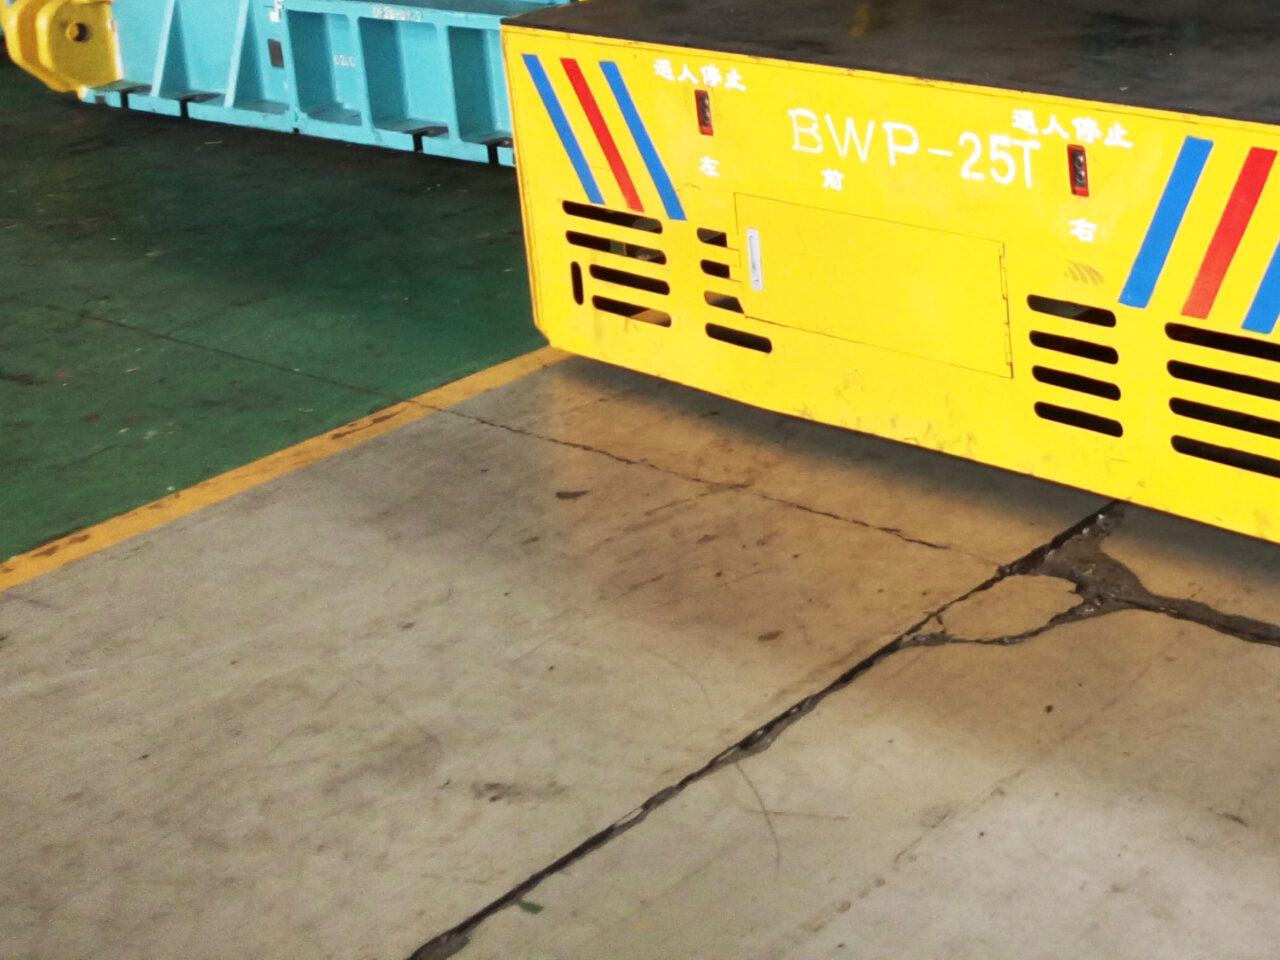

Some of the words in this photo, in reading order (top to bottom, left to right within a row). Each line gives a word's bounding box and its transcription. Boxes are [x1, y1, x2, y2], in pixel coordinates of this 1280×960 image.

[787, 108, 1041, 188] BWP-25T
[699, 156, 720, 177] 左
[820, 168, 845, 191] 前
[1068, 218, 1098, 243] 右
